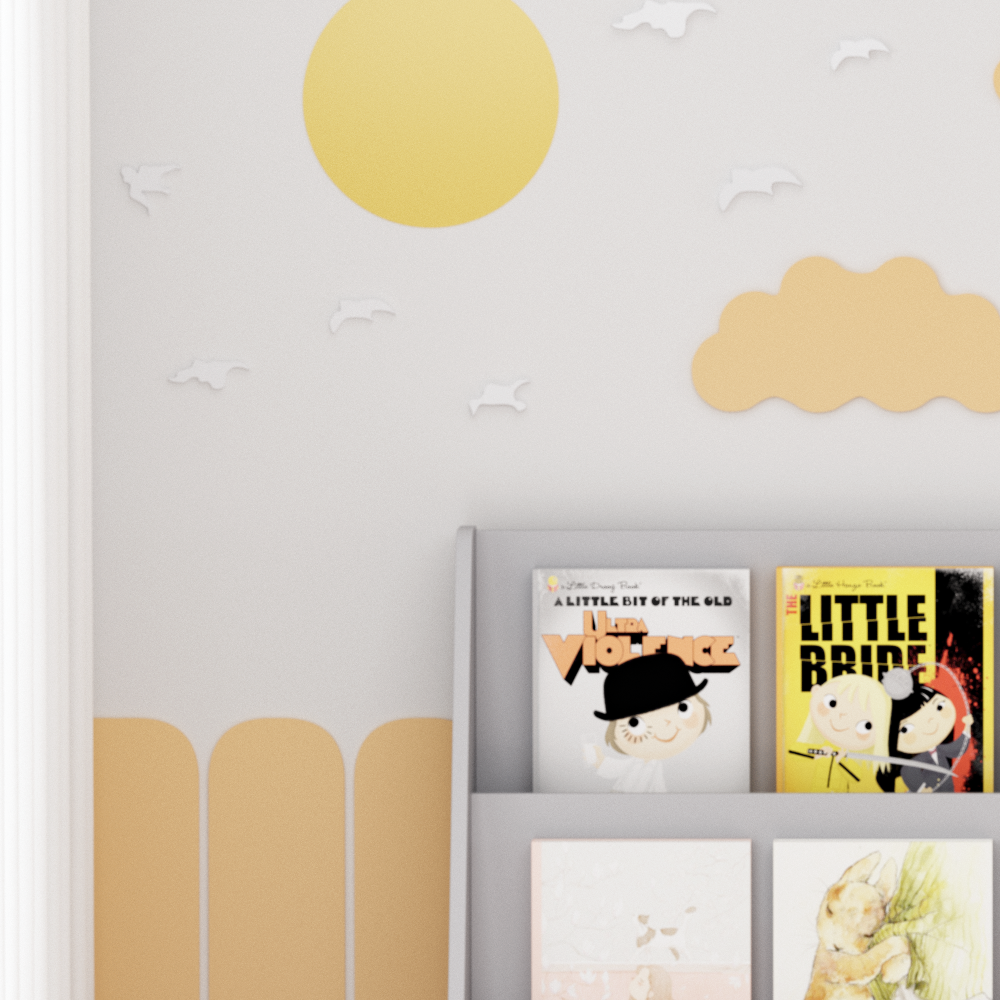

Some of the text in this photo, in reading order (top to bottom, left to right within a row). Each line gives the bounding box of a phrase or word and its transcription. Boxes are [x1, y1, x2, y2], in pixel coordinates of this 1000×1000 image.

[554, 596, 733, 606] A LITTLE BIT OF THE OLD
[786, 594, 797, 616] THE
[800, 594, 928, 642] LITTLE
[800, 644, 927, 692] BRIDE
